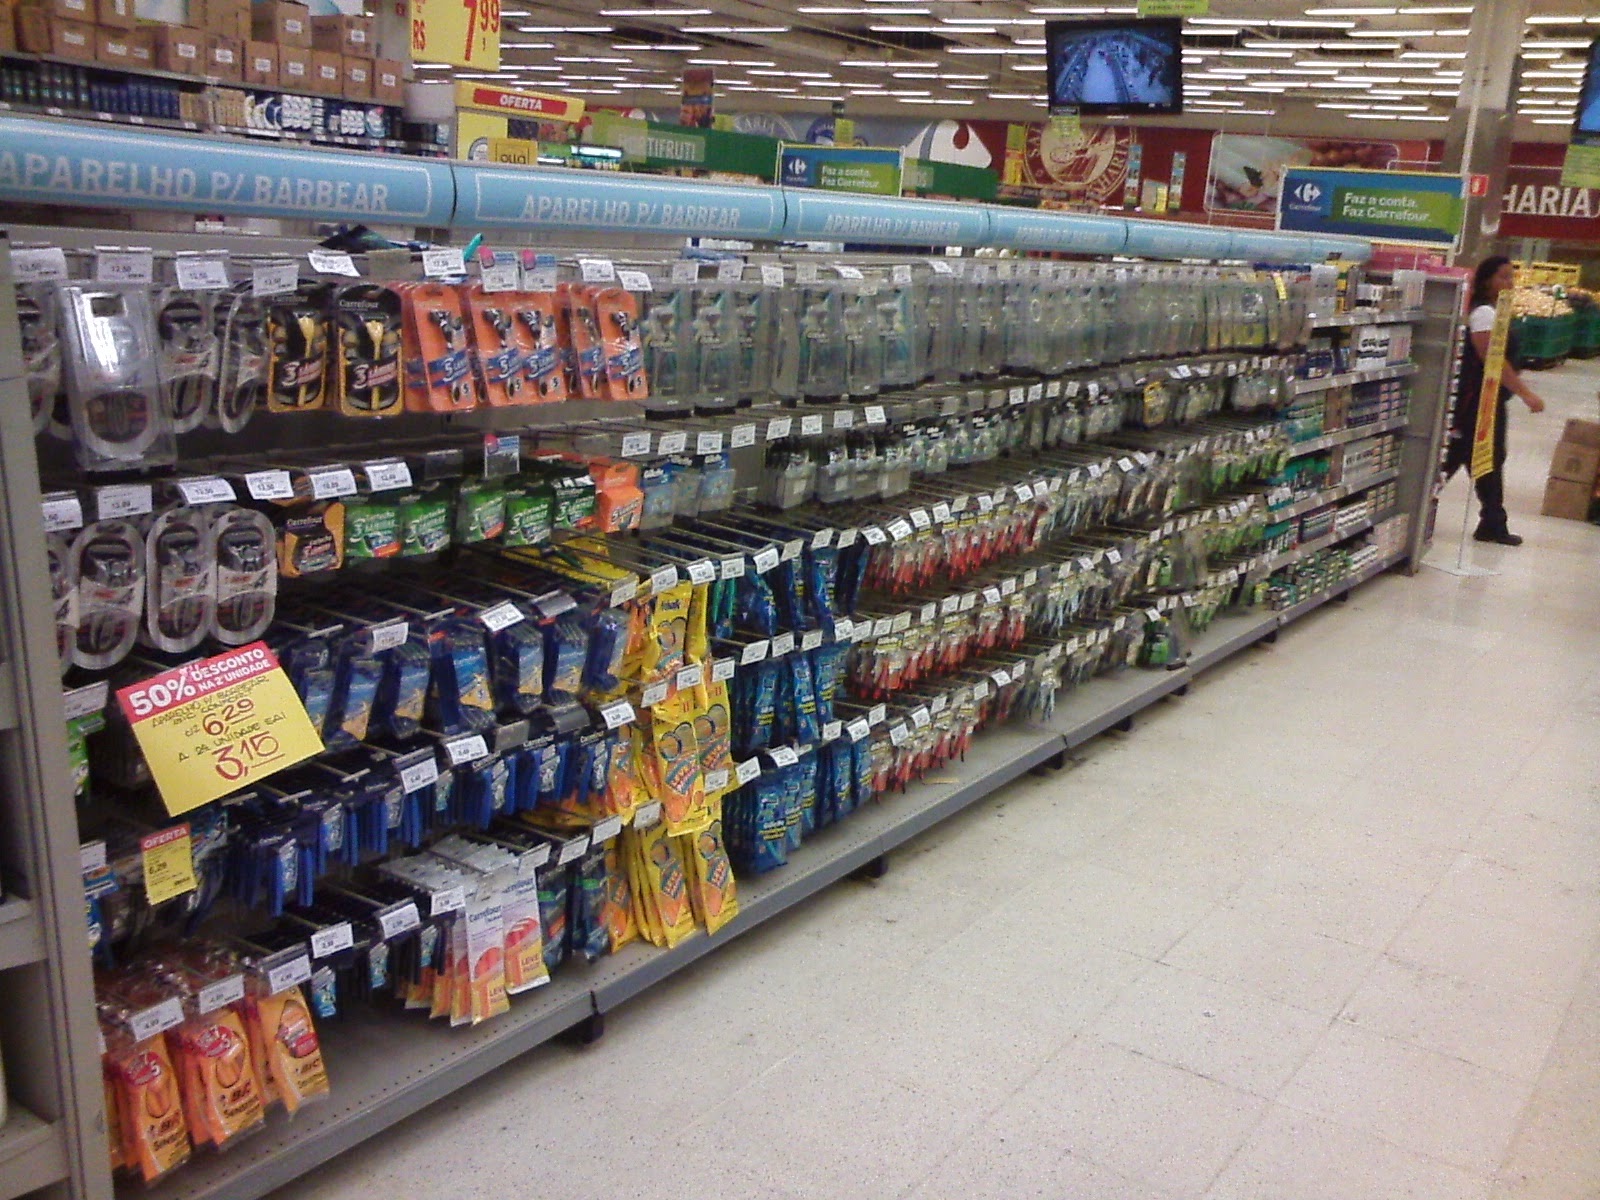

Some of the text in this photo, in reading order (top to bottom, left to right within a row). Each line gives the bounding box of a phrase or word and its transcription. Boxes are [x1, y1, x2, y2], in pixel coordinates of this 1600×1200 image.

[500, 93, 543, 111] OFERTA
[0, 151, 389, 212] APARELHO P/ BARBEAR
[520, 194, 741, 229] APARELHO P/ BARBEAR
[1342, 205, 1364, 217] Faz
[1344, 192, 1367, 205] Faz
[1368, 197, 1377, 205] a
[339, 299, 379, 309] Carrefour
[352, 363, 370, 389] 3
[190, 648, 265, 682] DESCONTO
[198, 679, 216, 692] NA
[224, 658, 271, 682] UNIDADE
[128, 675, 196, 716] 50%
[178, 752, 190, 763] A
[213, 722, 261, 747] UNIDADE
[143, 827, 188, 849] OFERTA
